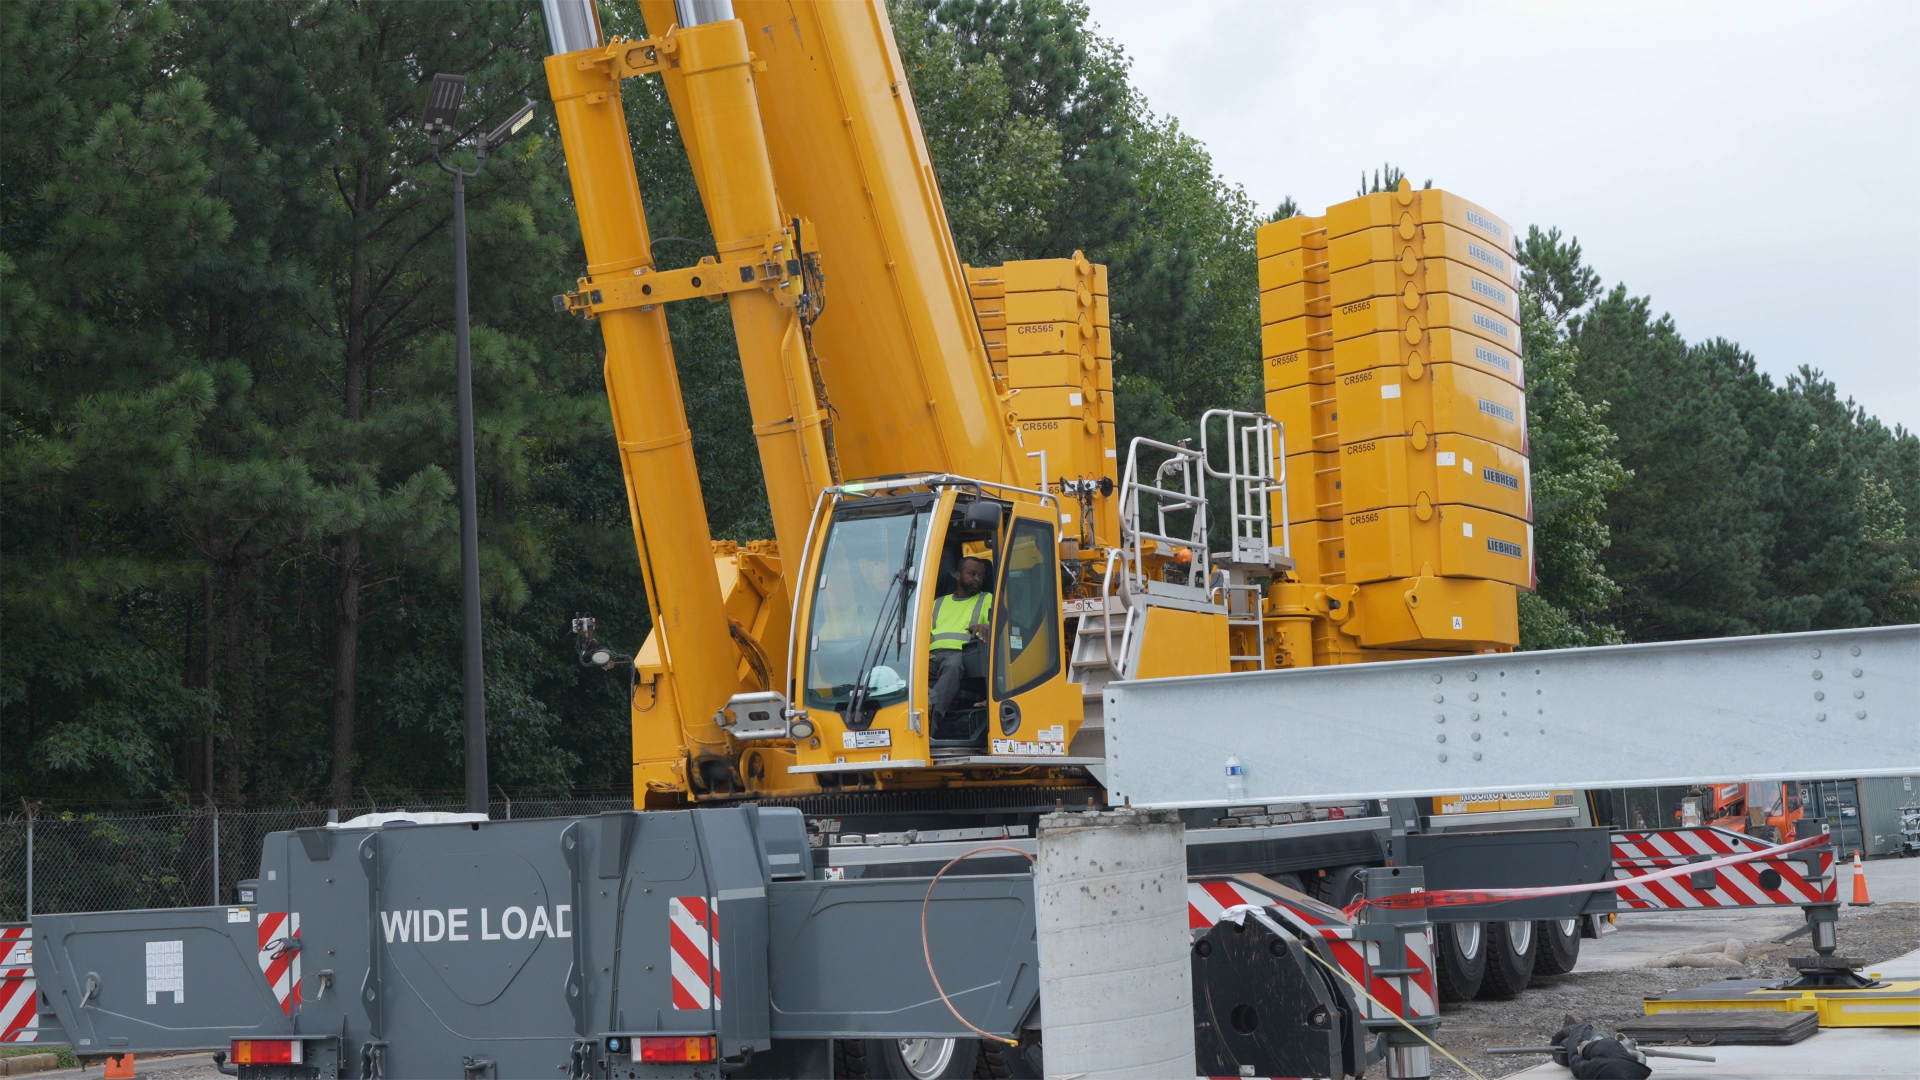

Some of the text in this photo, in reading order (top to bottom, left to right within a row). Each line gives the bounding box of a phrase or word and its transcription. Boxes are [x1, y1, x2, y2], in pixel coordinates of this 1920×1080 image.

[1469, 244, 1504, 271] LIEBHERR
[1471, 279, 1506, 304] LIEBHERR
[1342, 301, 1371, 315] CR5565
[1018, 324, 1054, 334] CR5565
[1473, 313, 1508, 339] LIEBHERR
[1271, 353, 1299, 367] CR5565
[1475, 347, 1511, 371] LIEBHERR
[1343, 371, 1373, 386] CR5565
[1479, 399, 1514, 422] LIEBHERR
[1022, 422, 1058, 431] CR5565
[1347, 442, 1376, 455] CR5565
[1484, 468, 1518, 490] LIEBHERR
[1350, 513, 1379, 526] CR5565
[1487, 539, 1522, 558] LIEBHERR
[1454, 618, 1461, 628] A
[380, 903, 572, 944] WIDE LOAD
